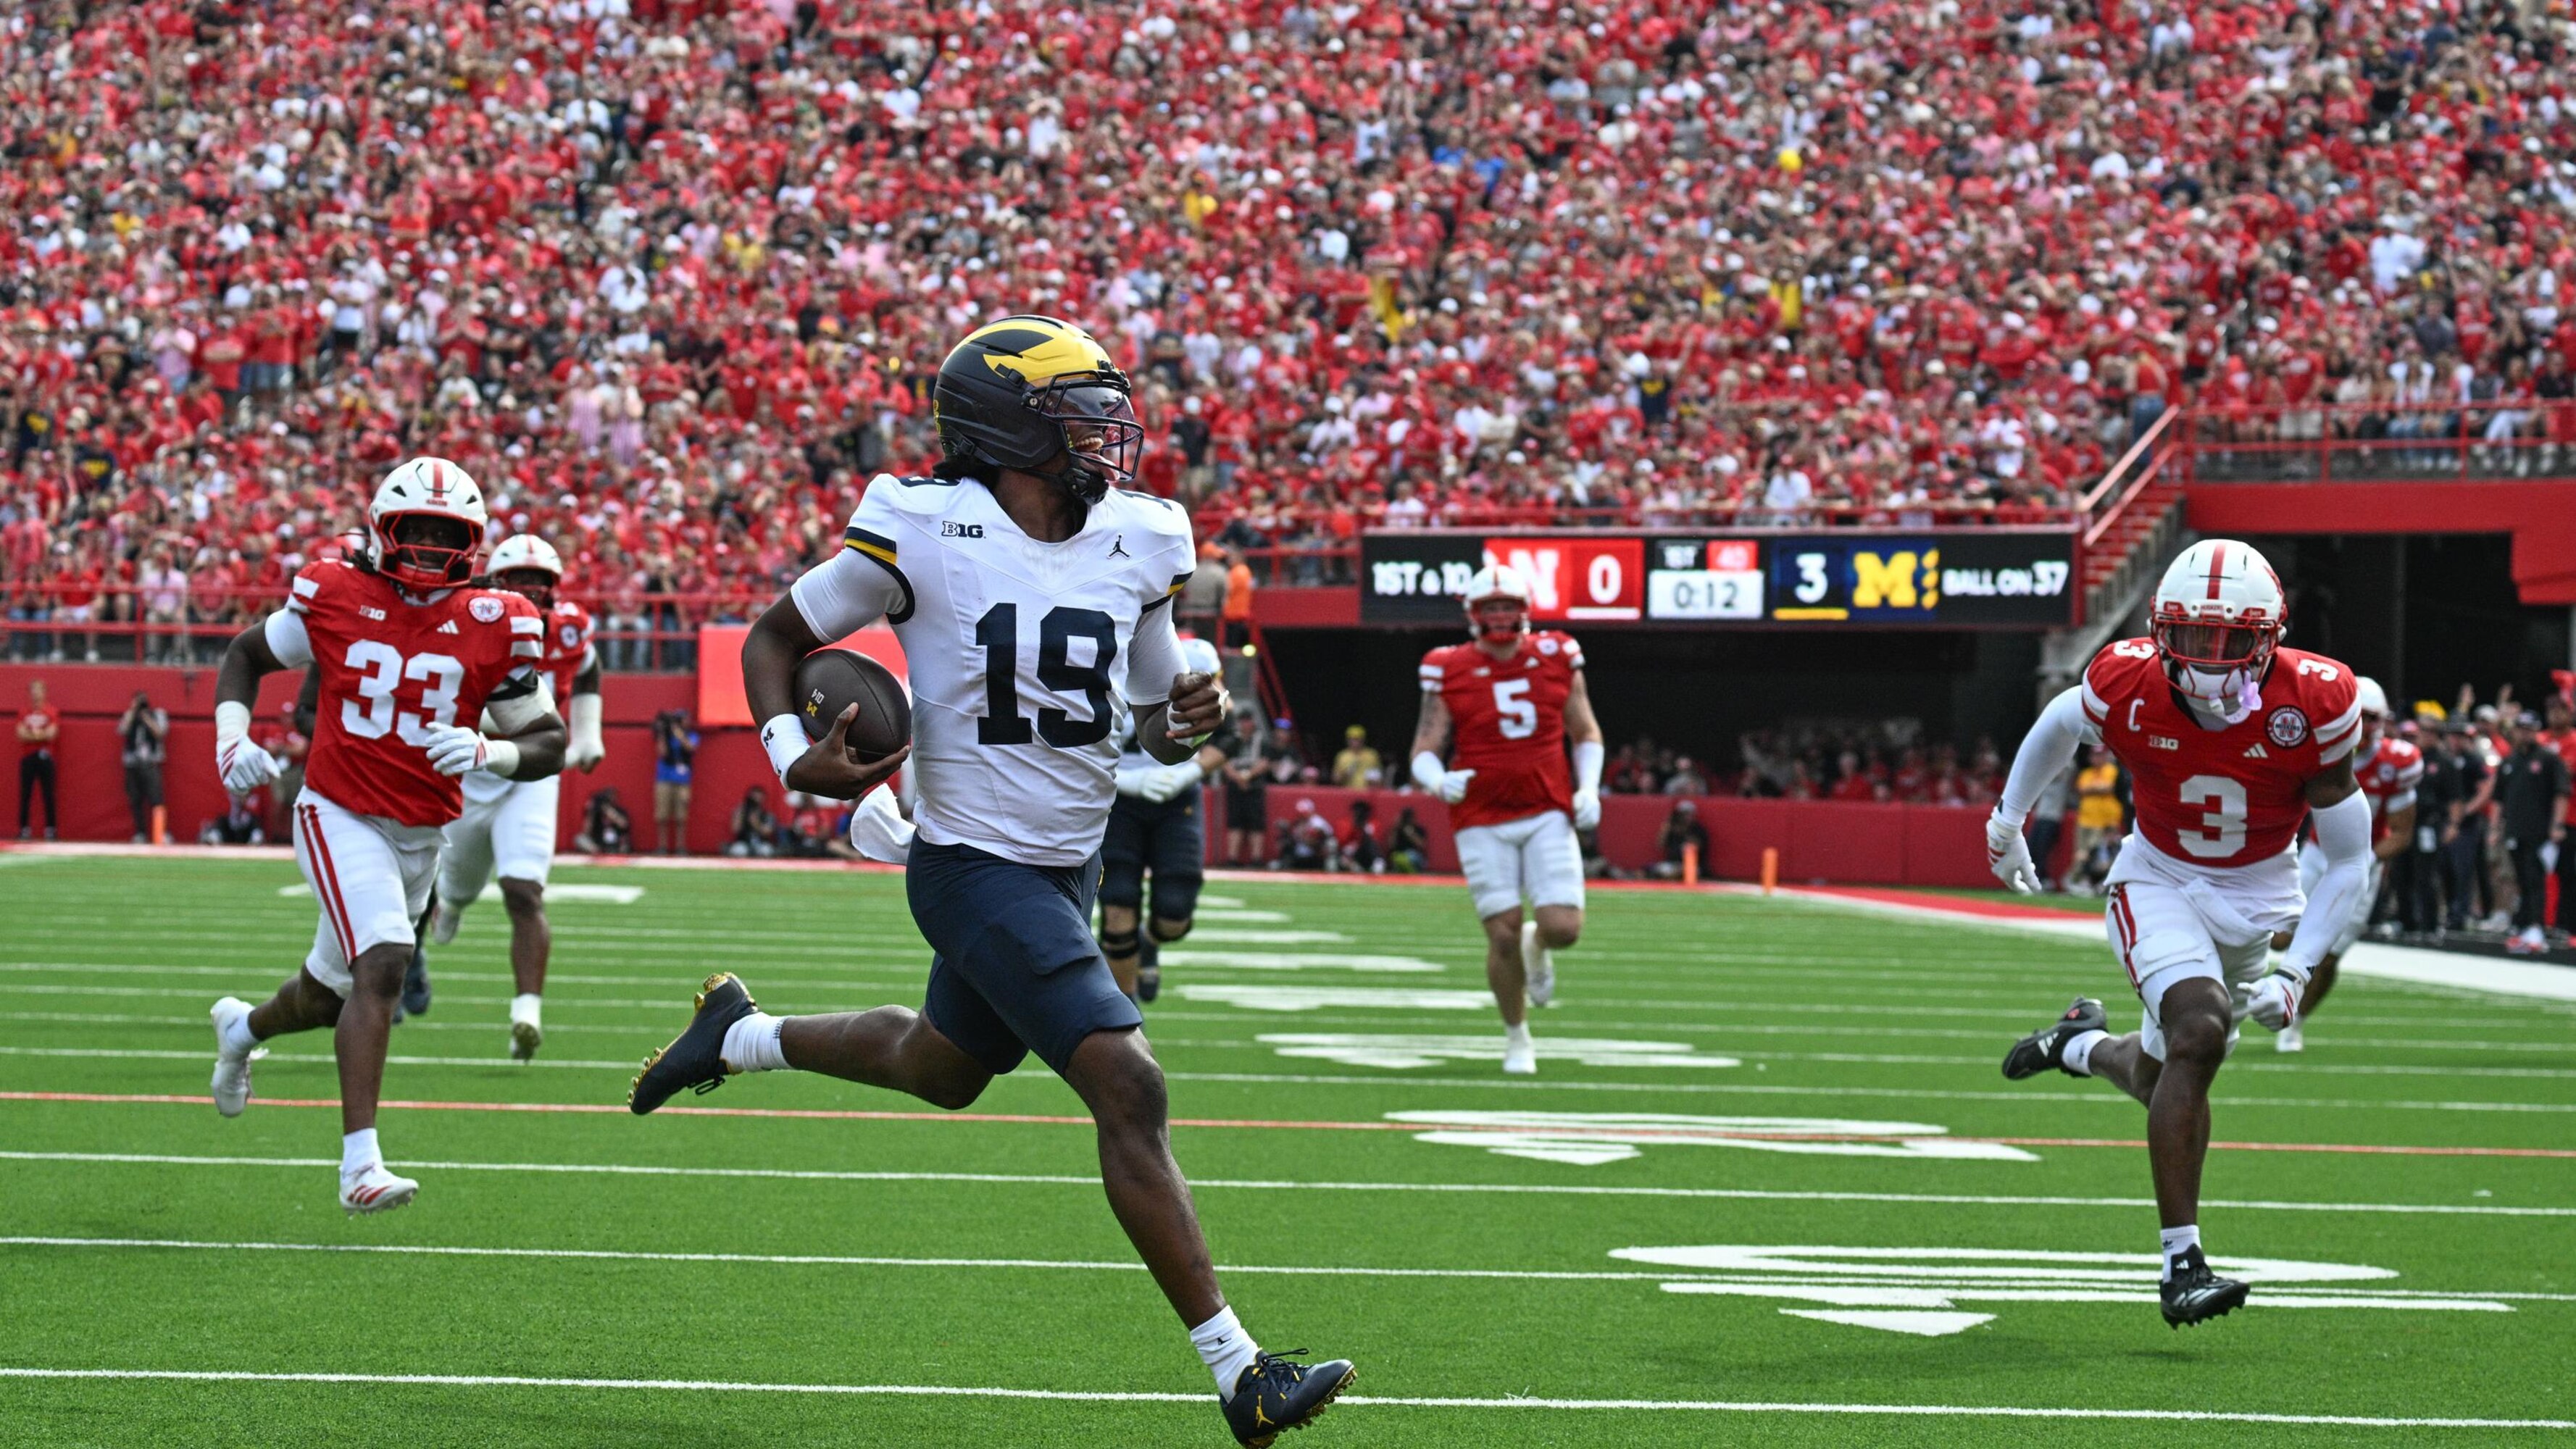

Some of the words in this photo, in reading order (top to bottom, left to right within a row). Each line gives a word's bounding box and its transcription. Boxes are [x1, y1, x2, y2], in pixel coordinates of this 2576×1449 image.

[1588, 554, 1622, 604] 0
[1673, 580, 1739, 609] 0:12
[1795, 552, 1828, 604] 3
[1852, 551, 1918, 609] M
[1941, 568, 1997, 596] BALL
[1996, 568, 2033, 596] ON
[2031, 560, 2069, 596] 37
[975, 602, 1117, 748] 19
[2113, 640, 2156, 660] 3
[2297, 658, 2339, 682] 3
[341, 638, 464, 747] 33
[1493, 677, 1537, 739] 5
[2129, 698, 2145, 731] C
[2177, 774, 2248, 858] 3
